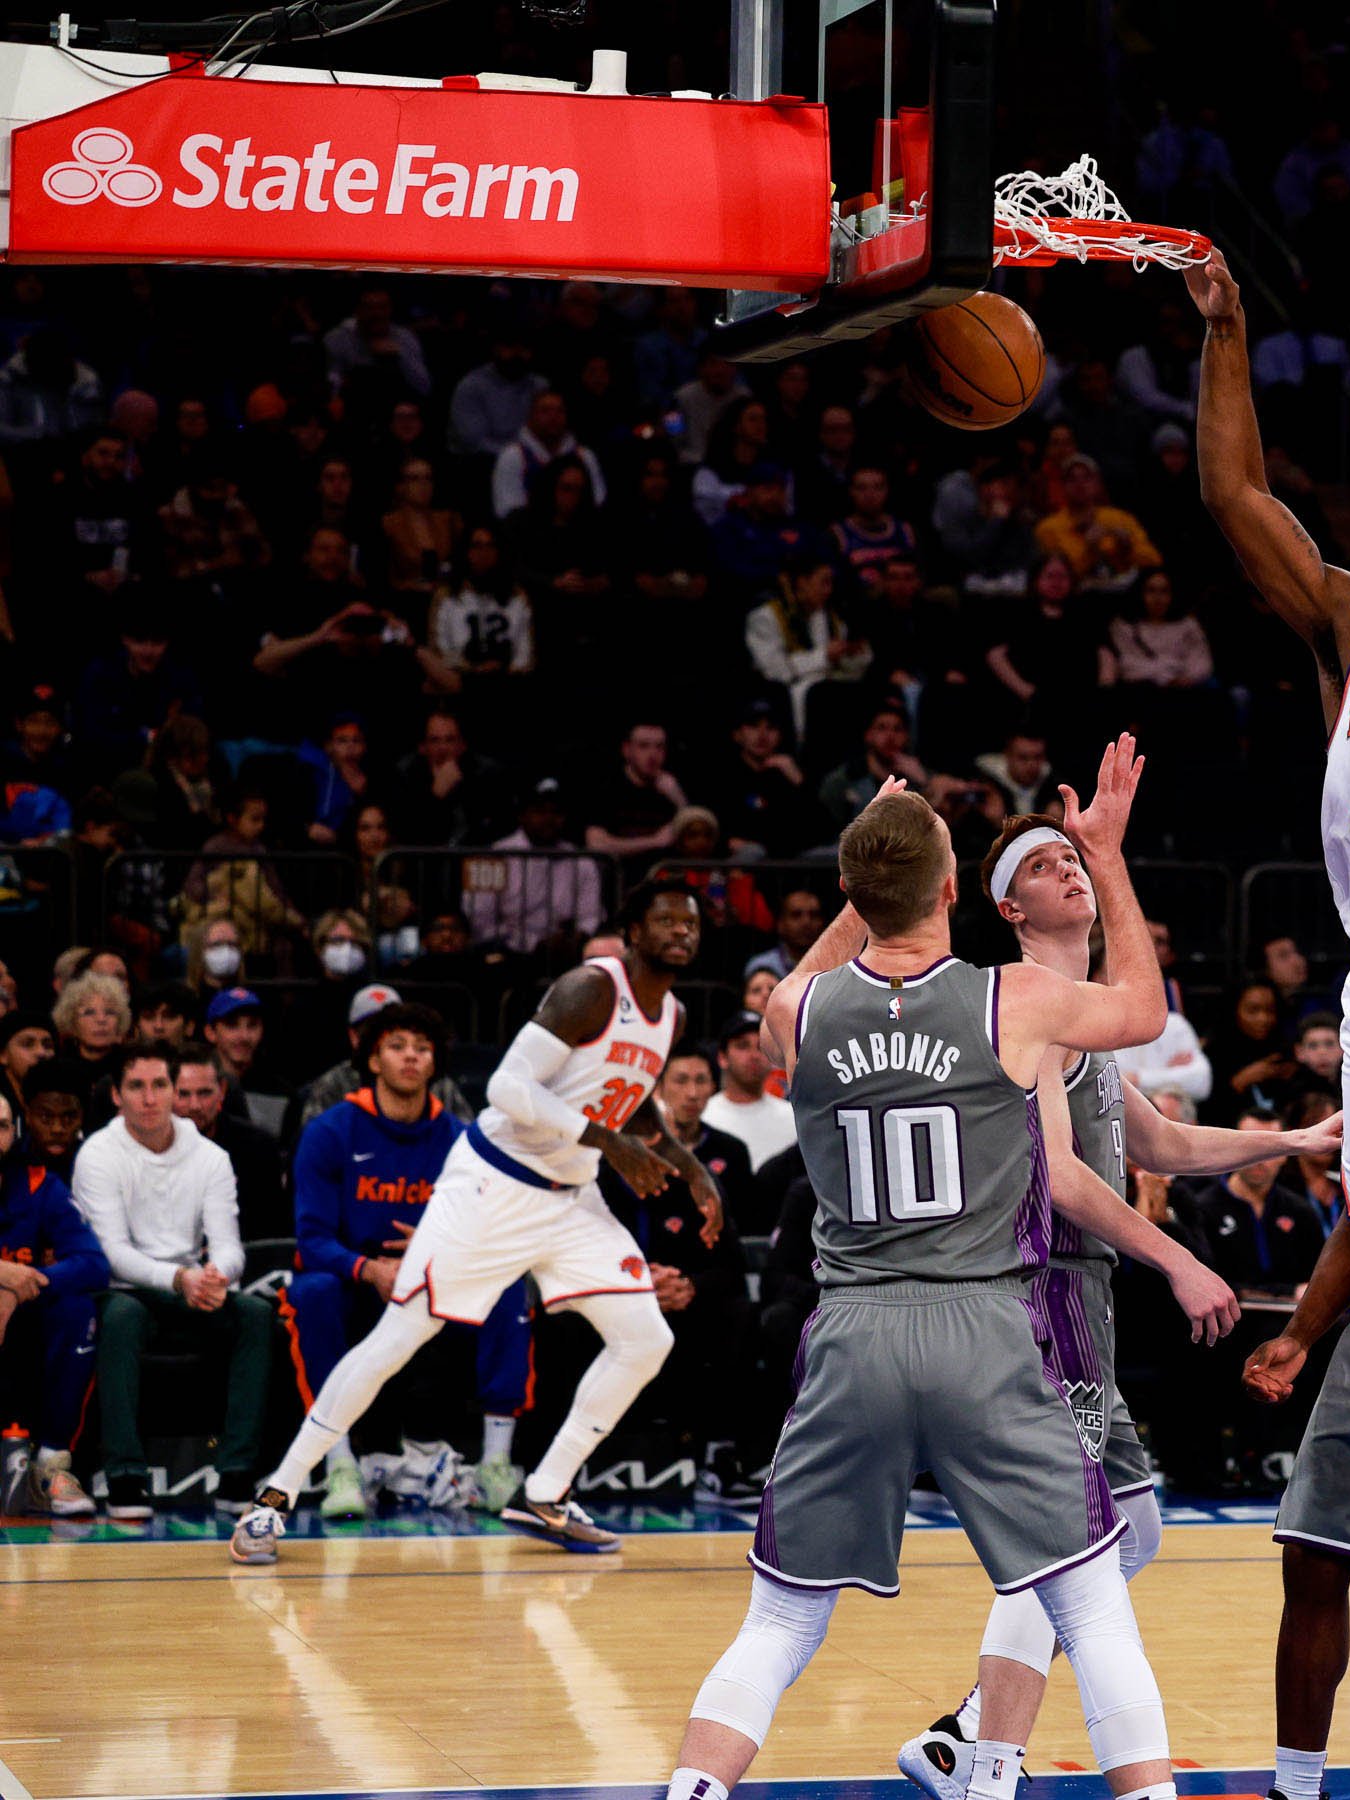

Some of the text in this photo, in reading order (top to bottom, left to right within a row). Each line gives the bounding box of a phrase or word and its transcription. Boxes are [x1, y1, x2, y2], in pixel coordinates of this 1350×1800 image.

[827, 1031, 961, 1085] SABONIS
[583, 1078, 645, 1132] 30
[833, 1102, 966, 1226] 10
